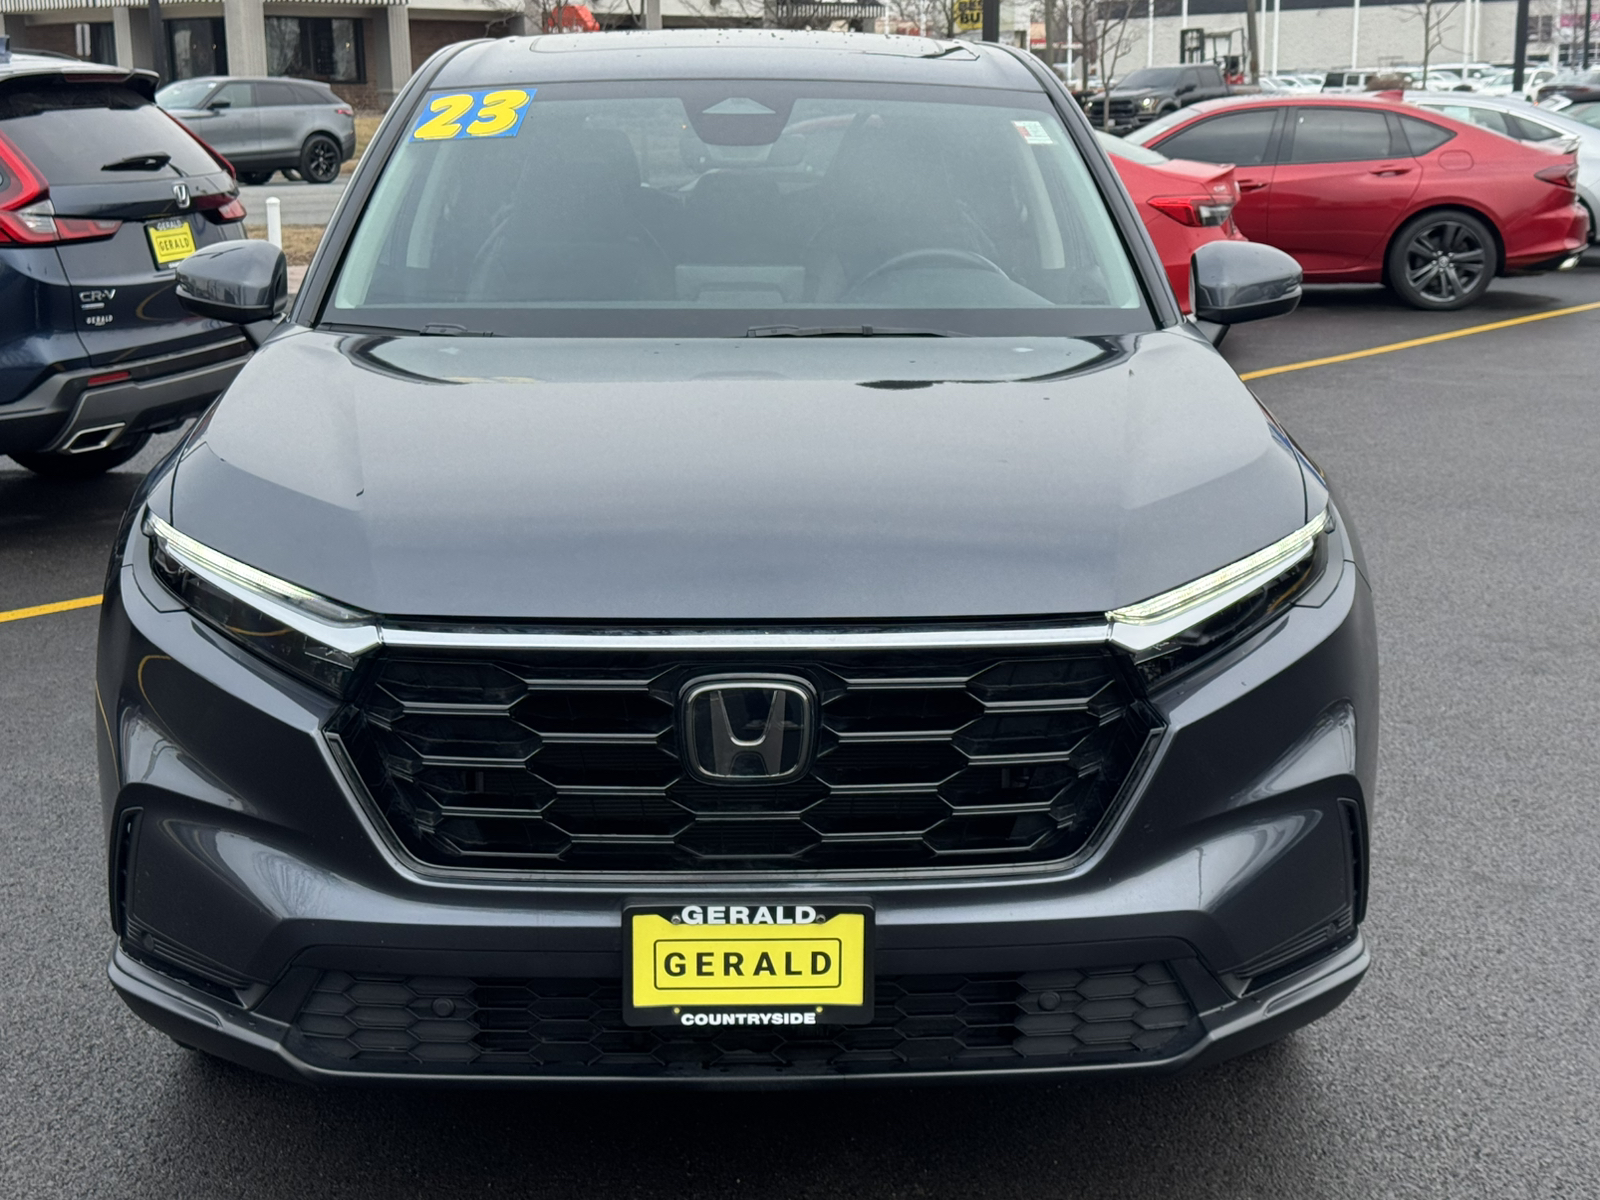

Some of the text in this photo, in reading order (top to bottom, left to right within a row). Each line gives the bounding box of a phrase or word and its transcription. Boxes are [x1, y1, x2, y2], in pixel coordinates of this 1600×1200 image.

[960, 12, 981, 24] BU
[413, 89, 530, 141] 23
[156, 220, 182, 230] GERALD
[159, 237, 189, 252] GERALD
[86, 314, 113, 325] GERALD
[681, 905, 817, 925] GERALD
[663, 951, 832, 977] GERALD
[680, 1012, 816, 1026] COUNTRYSIDE
